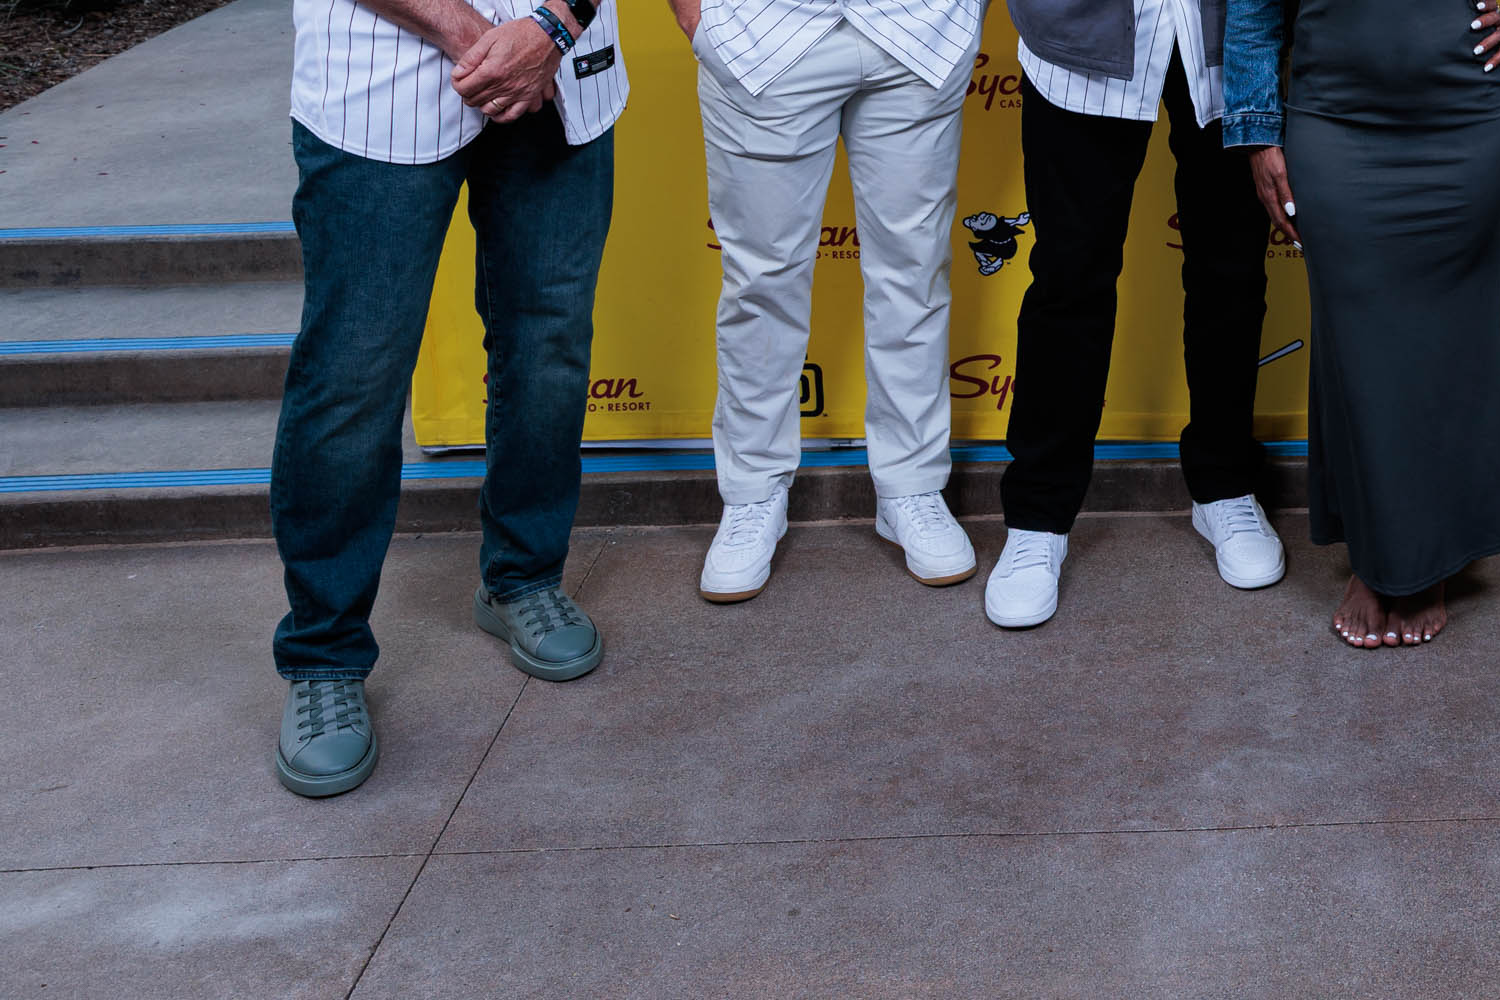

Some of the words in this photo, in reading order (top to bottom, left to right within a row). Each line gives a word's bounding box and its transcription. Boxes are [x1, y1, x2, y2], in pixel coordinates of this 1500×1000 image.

[1000, 100, 1021, 108] CAS
[832, 251, 860, 259] RESO
[608, 402, 651, 411] RESORT
